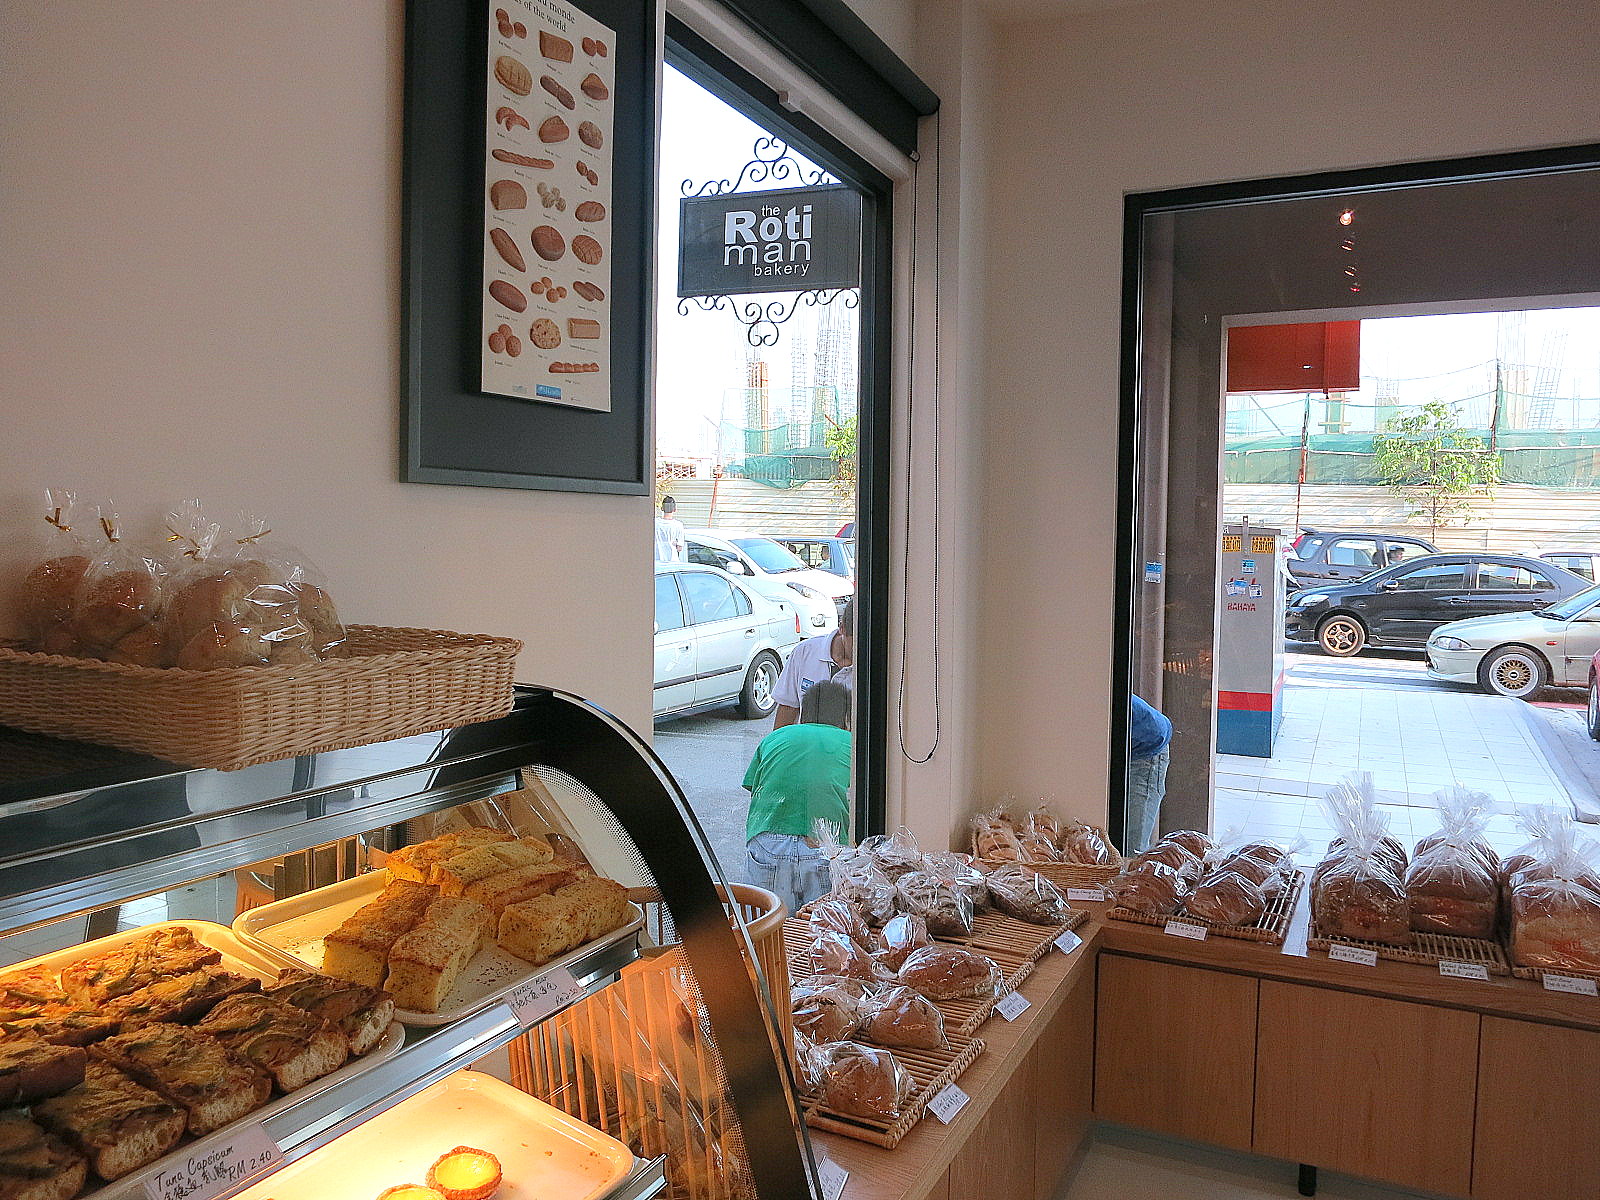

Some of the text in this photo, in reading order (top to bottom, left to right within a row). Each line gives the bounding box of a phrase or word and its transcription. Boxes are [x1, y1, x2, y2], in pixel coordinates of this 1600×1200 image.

[523, 1, 567, 33] of the world
[549, 2, 575, 24] monde
[761, 204, 781, 217] the
[725, 204, 813, 245] Roti
[723, 240, 812, 266] man
[754, 263, 810, 277] bakery
[1227, 602, 1256, 612] BAHAYA
[153, 1145, 234, 1192] Tuna Capsicum
[228, 1150, 273, 1182] RM 2.40
